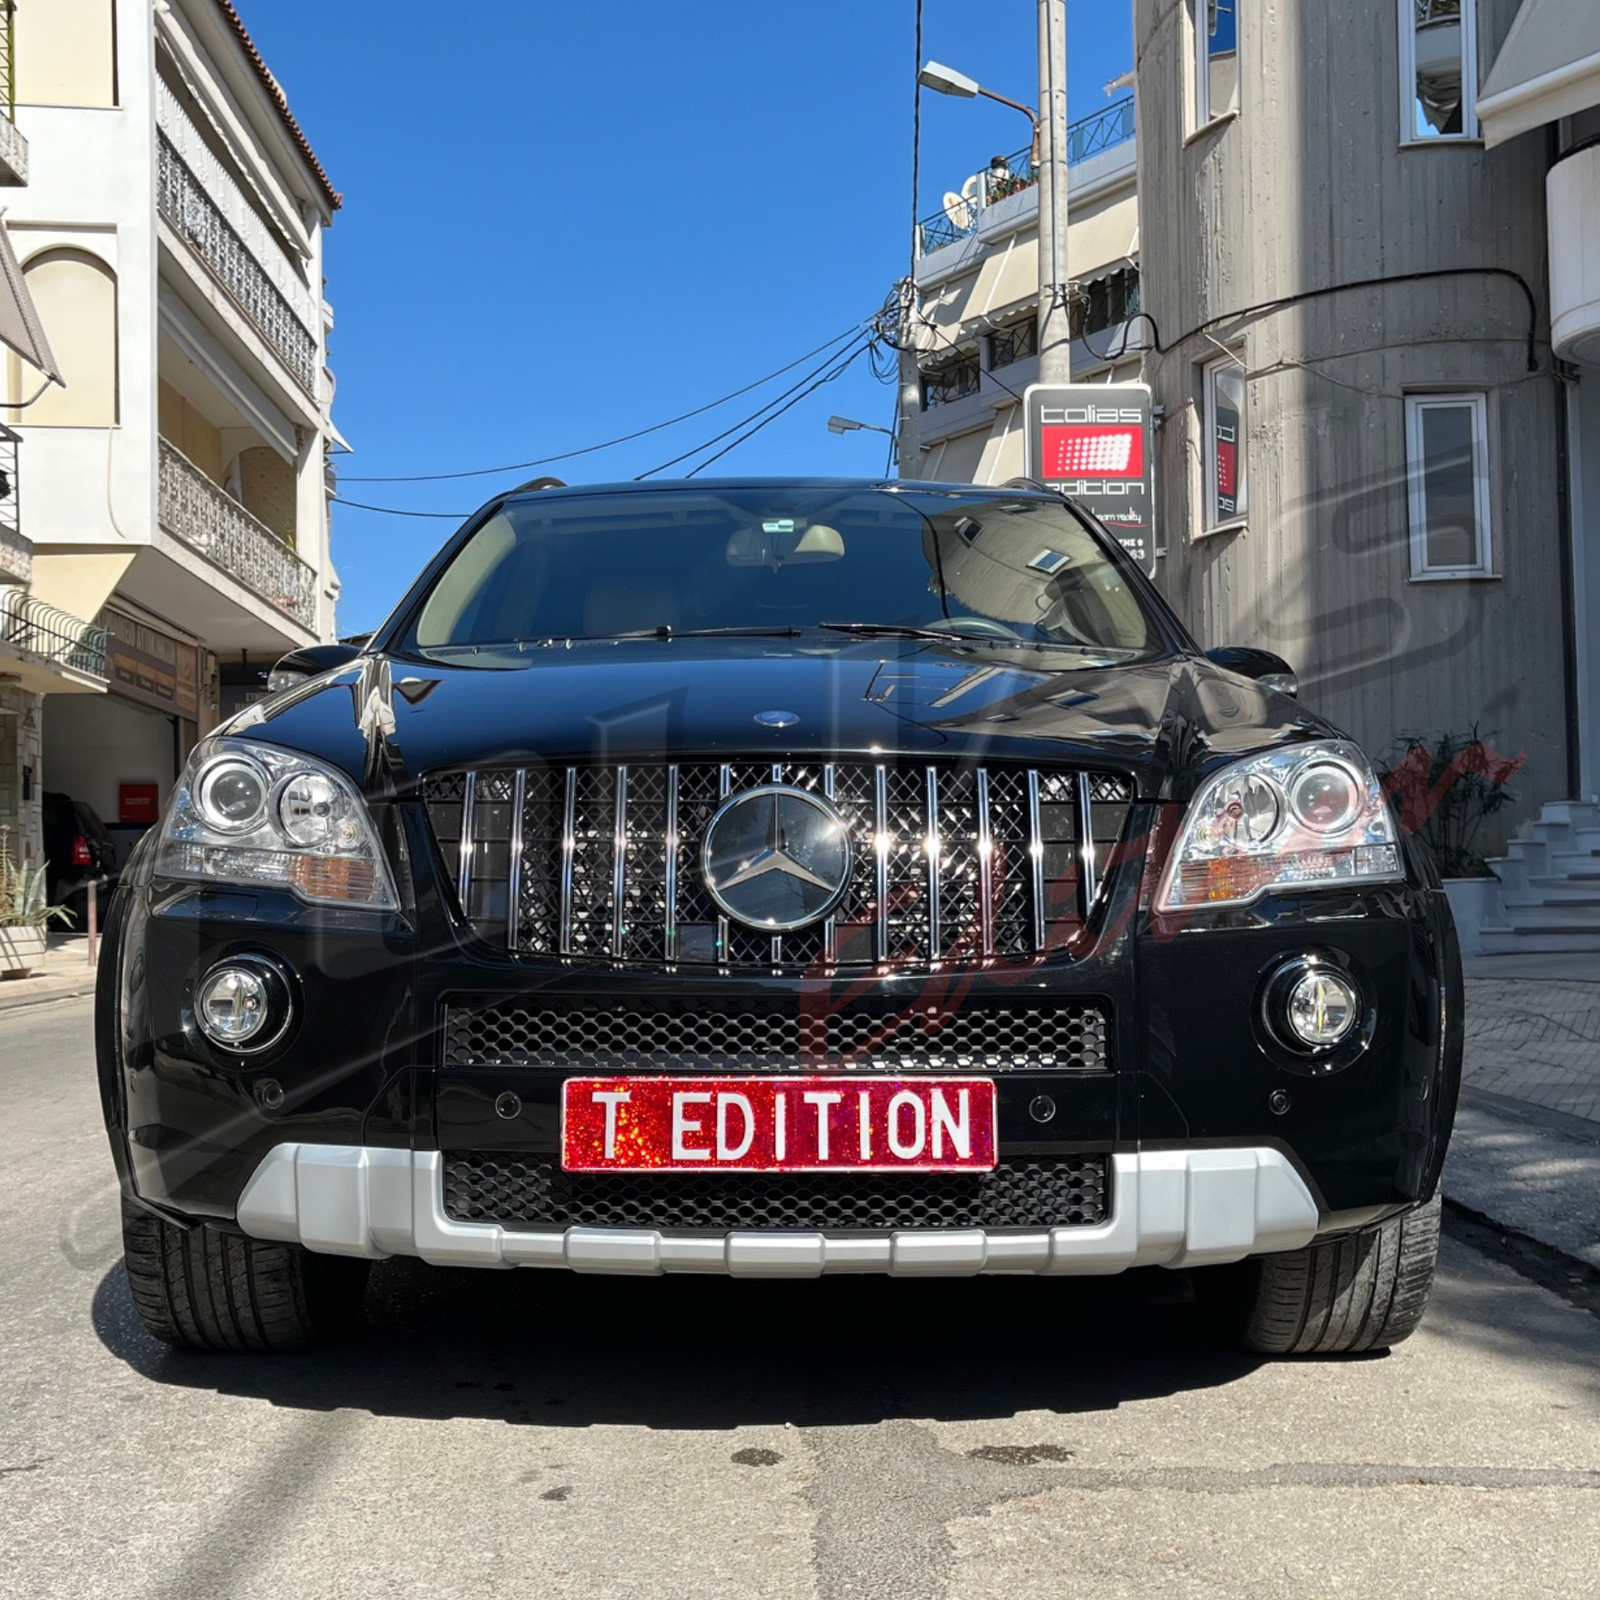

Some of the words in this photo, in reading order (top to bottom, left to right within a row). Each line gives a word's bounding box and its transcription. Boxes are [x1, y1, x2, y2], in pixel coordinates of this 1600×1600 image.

[1041, 405, 1141, 423] tolias
[592, 1091, 631, 1160] T
[671, 1089, 971, 1161] EDITION
